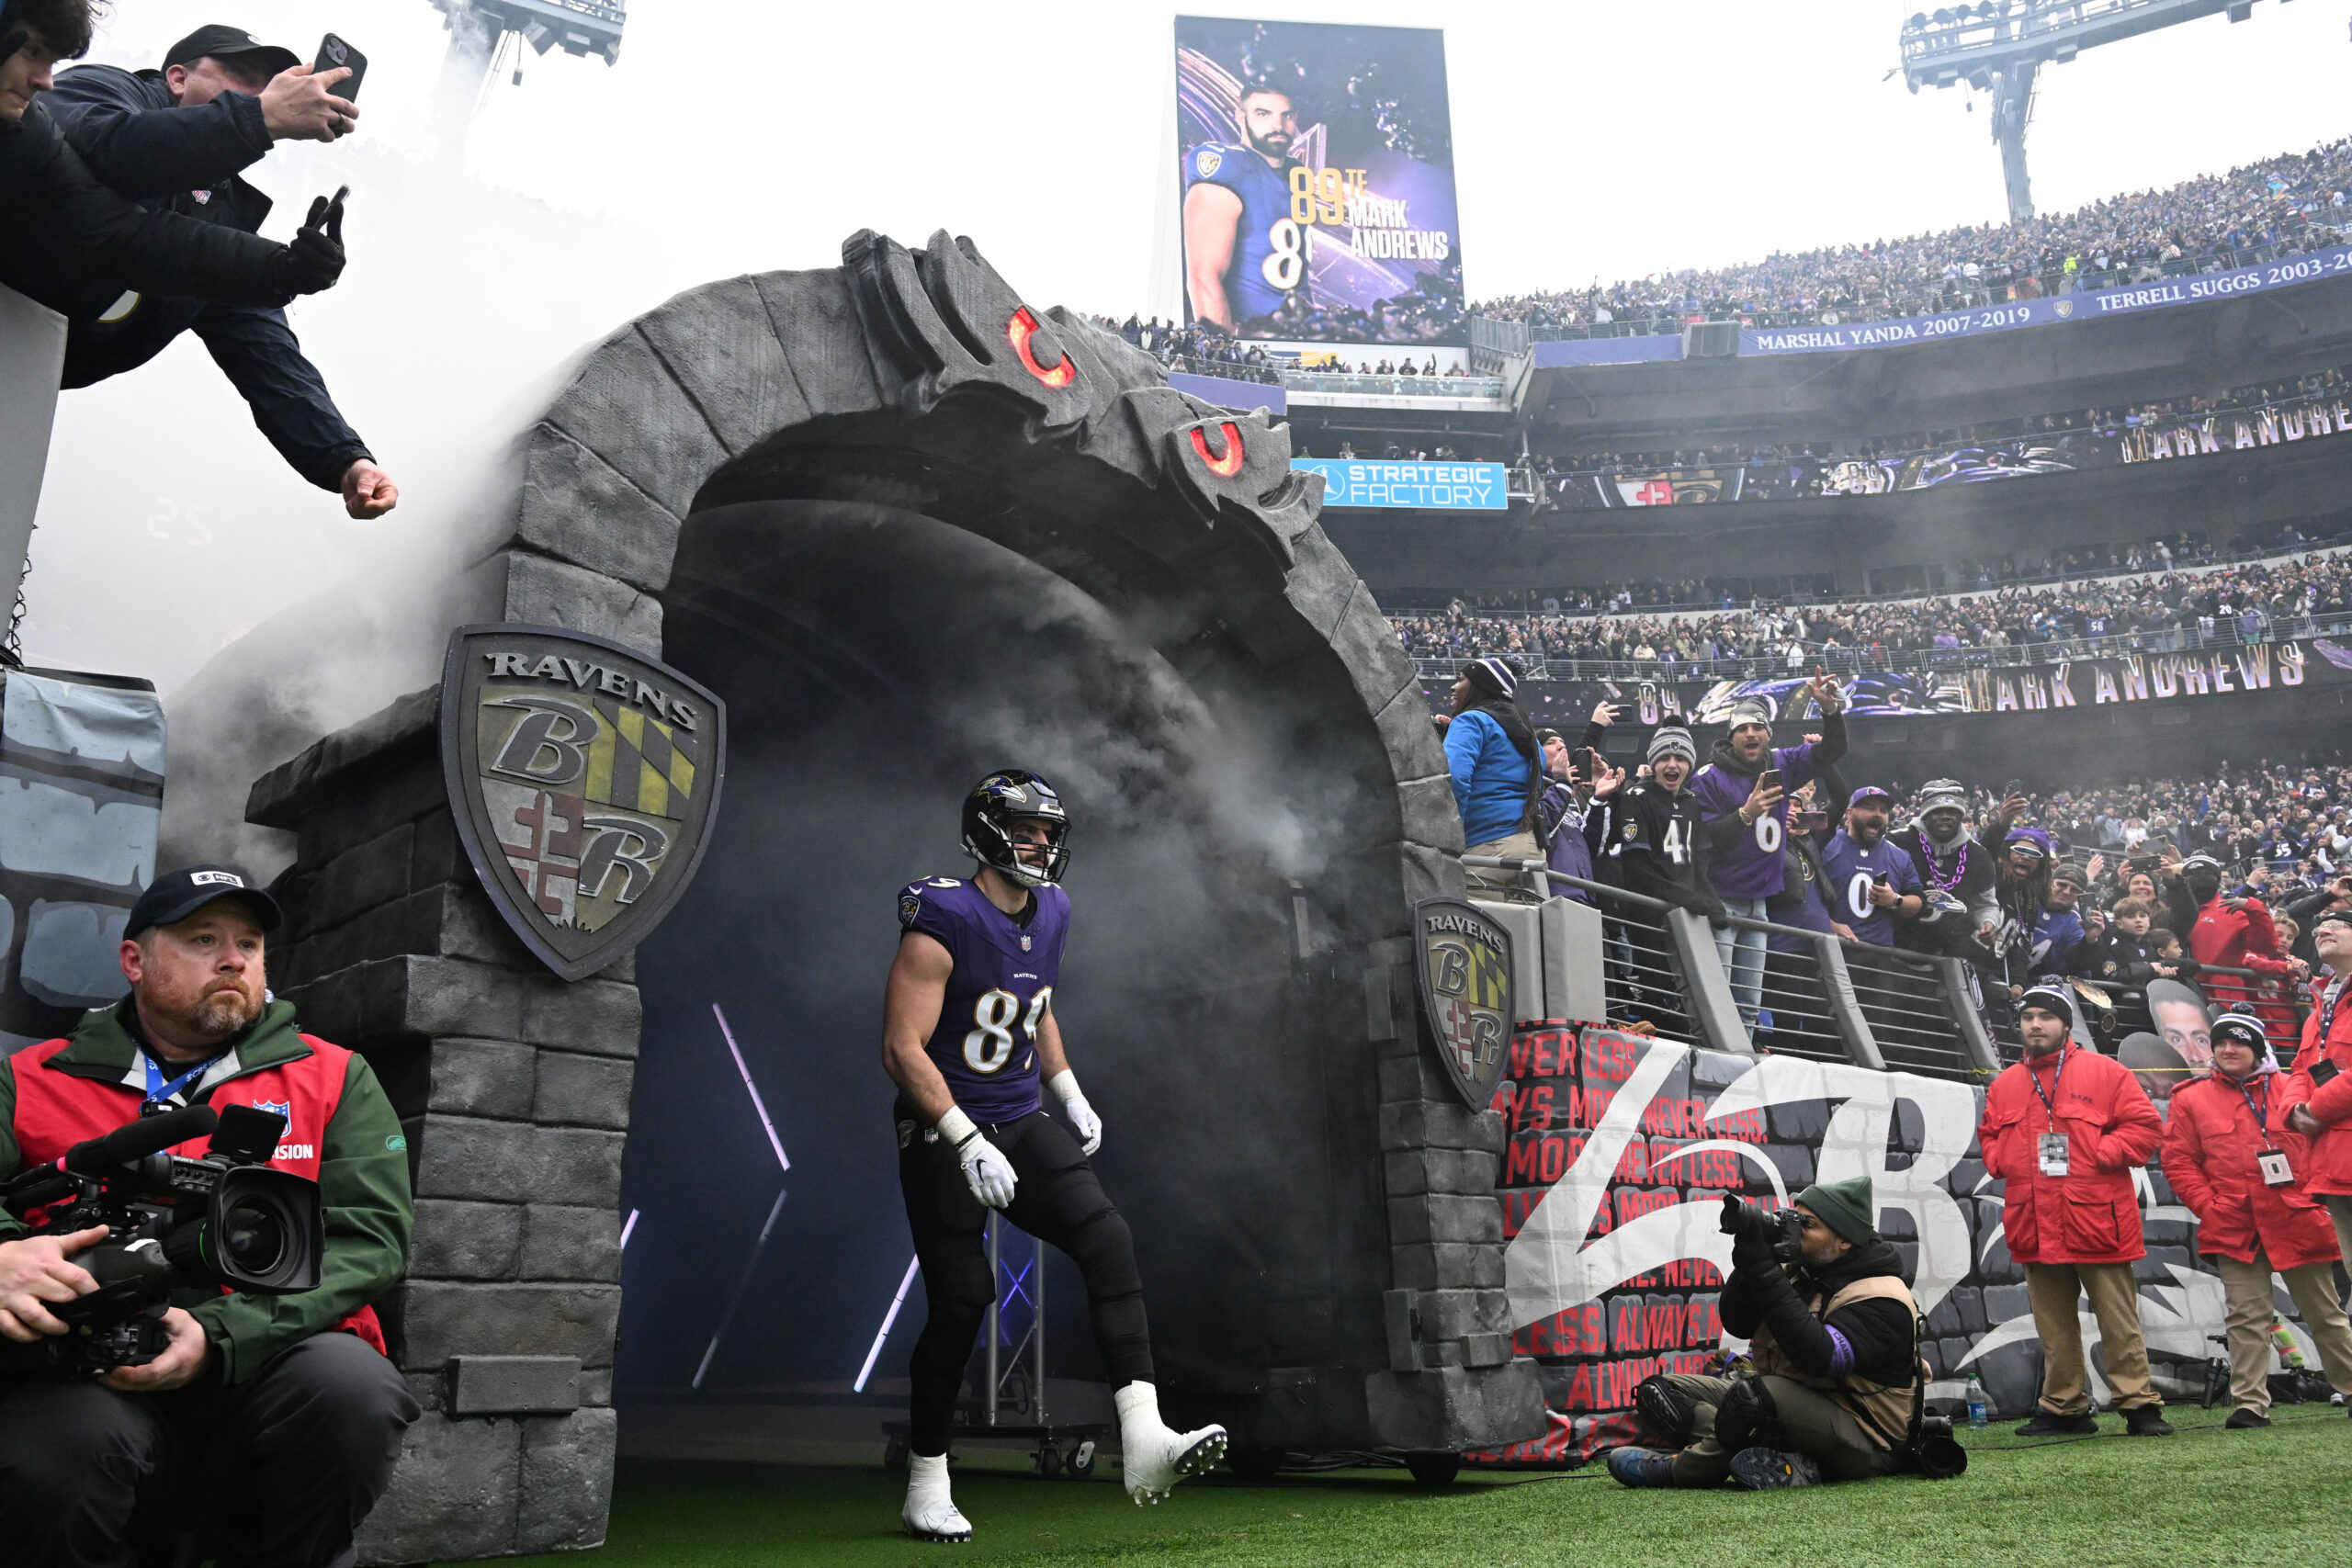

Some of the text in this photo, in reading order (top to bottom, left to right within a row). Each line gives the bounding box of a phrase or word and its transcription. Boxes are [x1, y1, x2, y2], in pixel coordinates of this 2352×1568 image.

[1289, 166, 1345, 225] 89
[1345, 168, 1368, 197] TE
[1348, 198, 1408, 229] MARK
[1351, 228, 1449, 260] ANDREWS
[2097, 285, 2186, 311] TERRELL
[2190, 272, 2261, 299] SUGGS
[1758, 331, 1846, 351] MARSHAL
[1849, 323, 1917, 345] YANDA
[1923, 306, 2031, 336] 2007-2019
[1348, 465, 1493, 484] STRATEGIC
[1351, 483, 1492, 506] FACTORY
[483, 652, 698, 732] RAVENS
[2094, 641, 2305, 705] ANDREWS
[482, 694, 602, 785] B
[1755, 810, 1781, 853] 6
[1848, 872, 1875, 919] 0
[1426, 915, 1504, 953] RAVENS
[1012, 972, 1038, 980] RAVENS
[1644, 1095, 1709, 1139] NEVER
[271, 1144, 313, 1161] ISION
[1665, 1258, 1724, 1287] NEVE
[1614, 1303, 1700, 1352] ALWAYS
